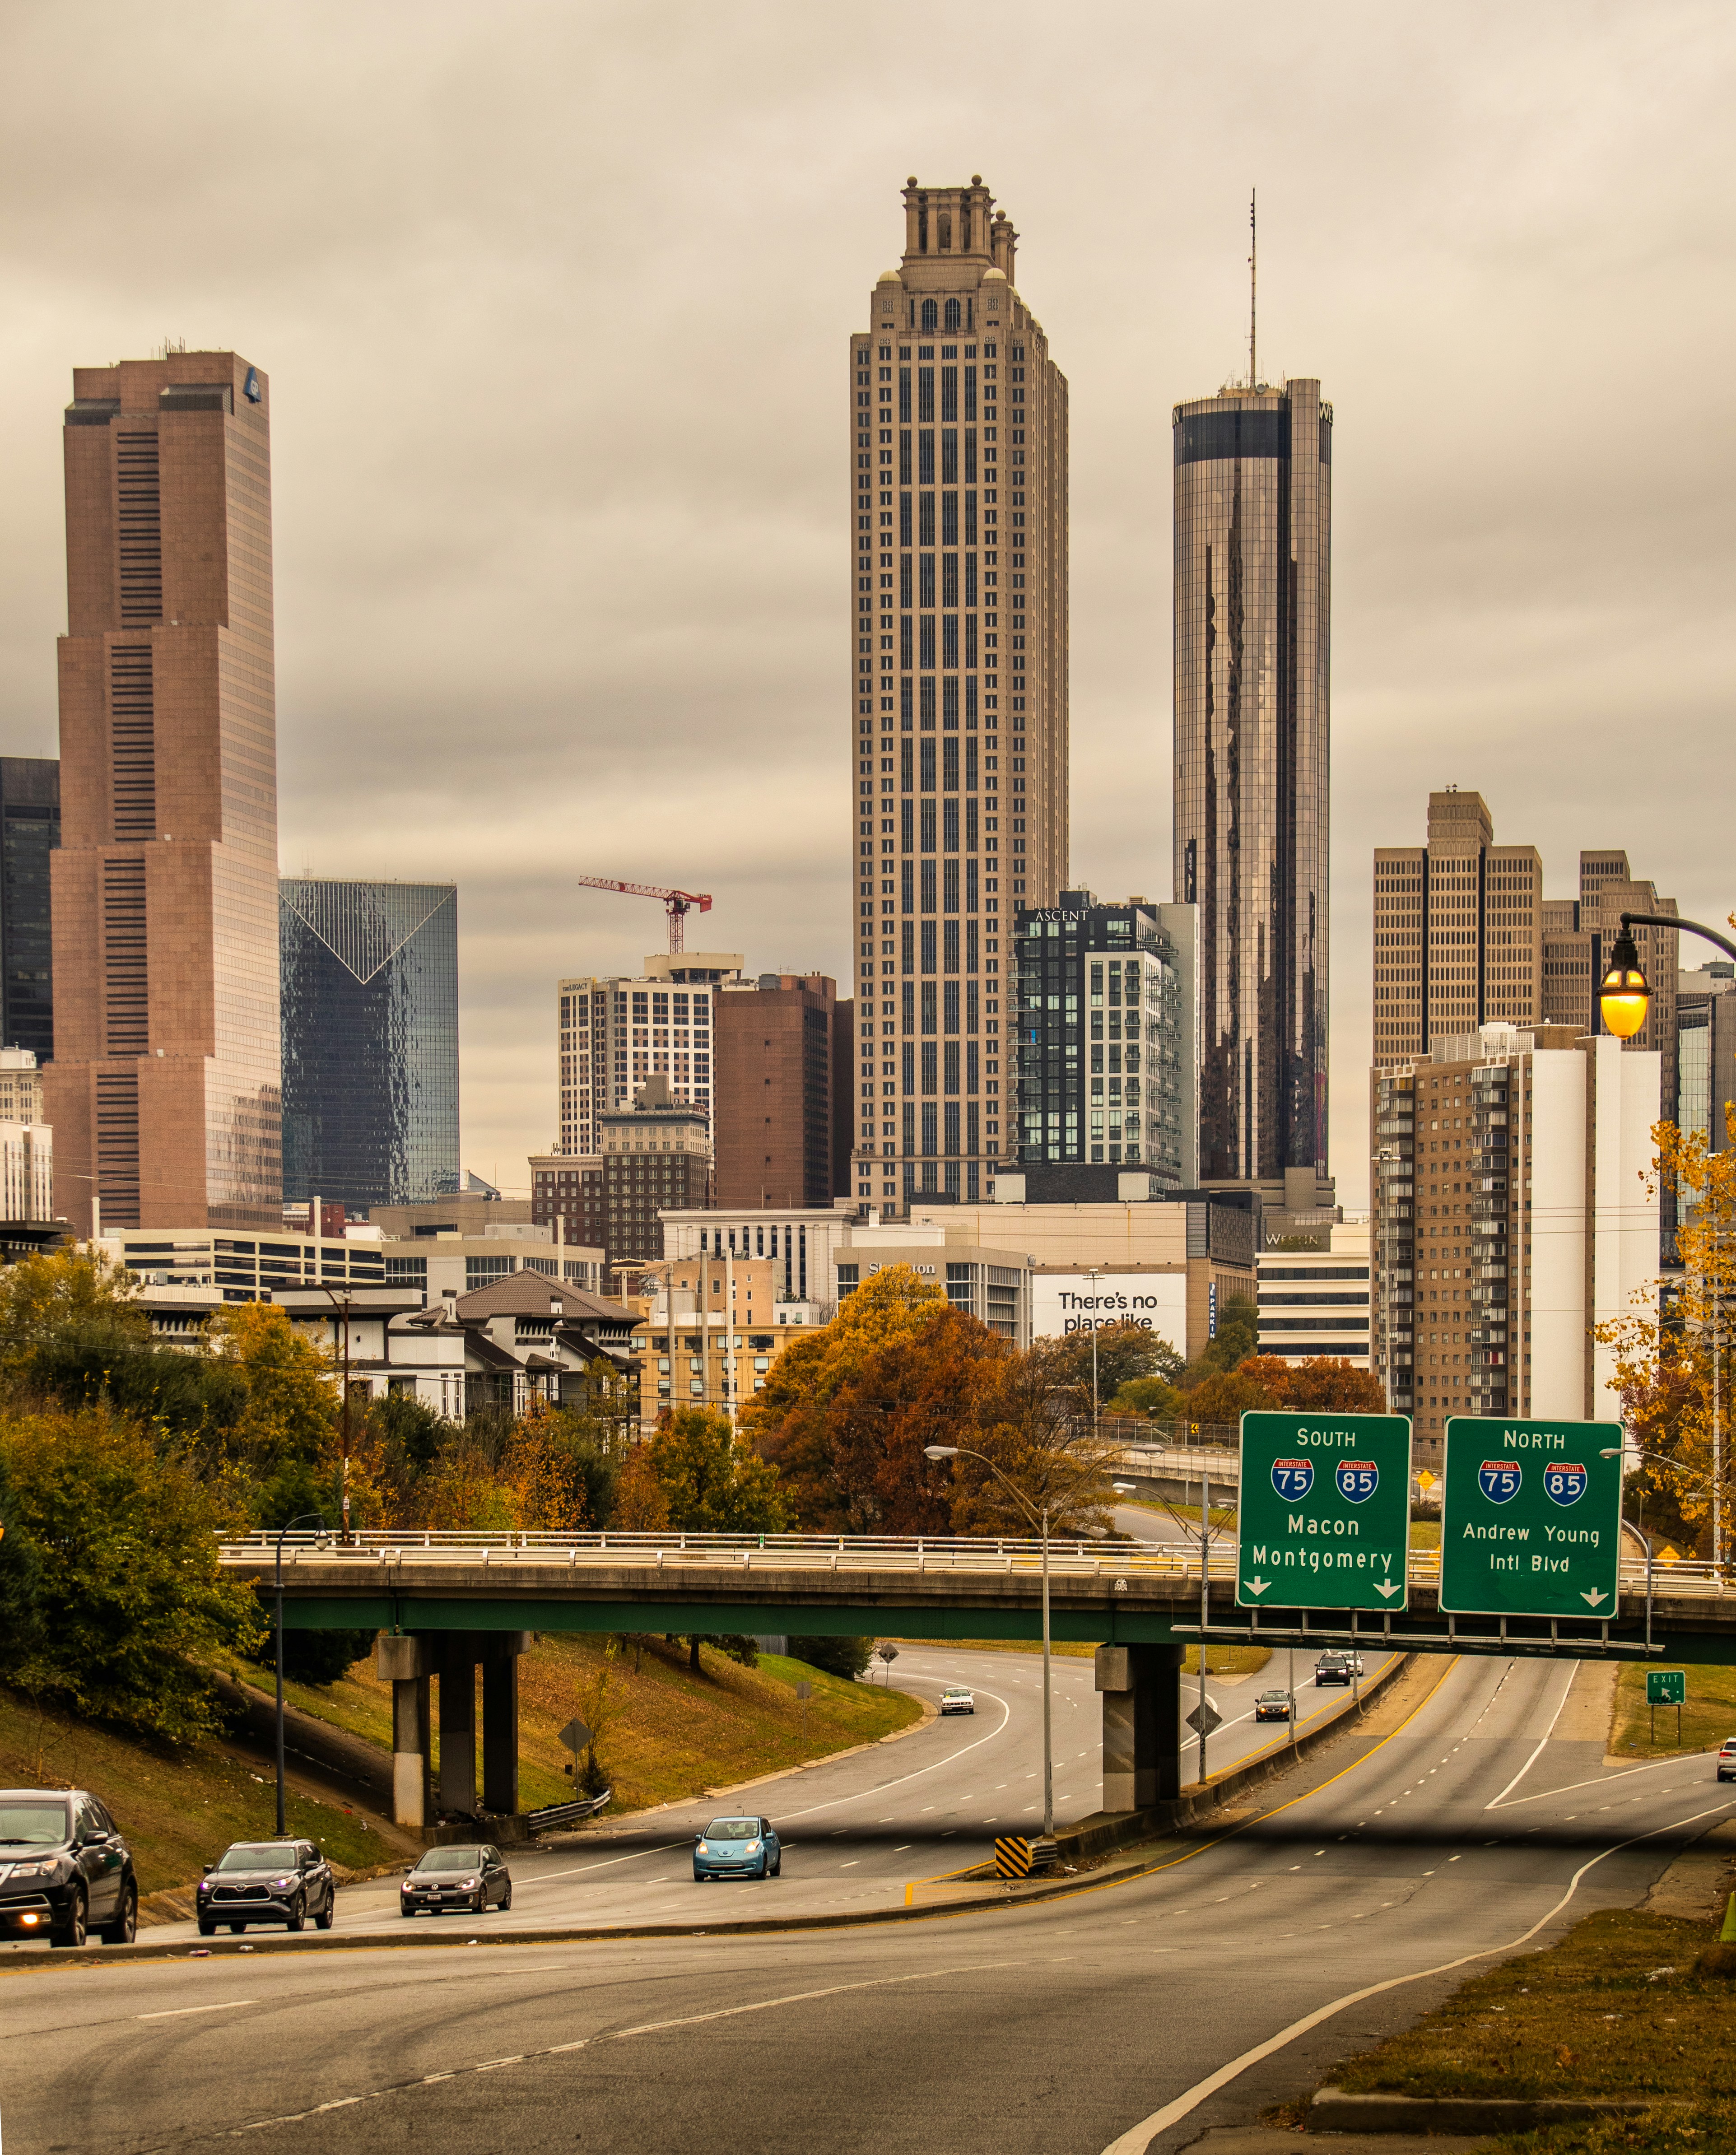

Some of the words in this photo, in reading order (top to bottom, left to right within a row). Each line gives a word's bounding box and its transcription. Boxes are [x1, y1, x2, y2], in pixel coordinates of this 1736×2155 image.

[1036, 910, 1089, 921] ASCENT
[569, 982, 588, 991] LEGACY
[869, 1262, 935, 1274] Ston
[1133, 1296, 1158, 1308] no
[1065, 1314, 1116, 1335] place
[1121, 1313, 1153, 1331] like
[1297, 1428, 1355, 1447] SOUTH
[1504, 1430, 1564, 1449] NORTH
[1277, 1471, 1307, 1490] 75
[1342, 1472, 1372, 1492] 85
[1485, 1472, 1514, 1492] 75
[1550, 1475, 1580, 1495] 85
[1289, 1514, 1359, 1535] Macon
[1463, 1523, 1530, 1541] Andrew
[1545, 1526, 1599, 1548] Young
[1254, 1545, 1392, 1573] Montgomery
[1490, 1554, 1519, 1570] Intl
[1532, 1555, 1569, 1572] Blvd
[1653, 1675, 1678, 1683] EXIT
